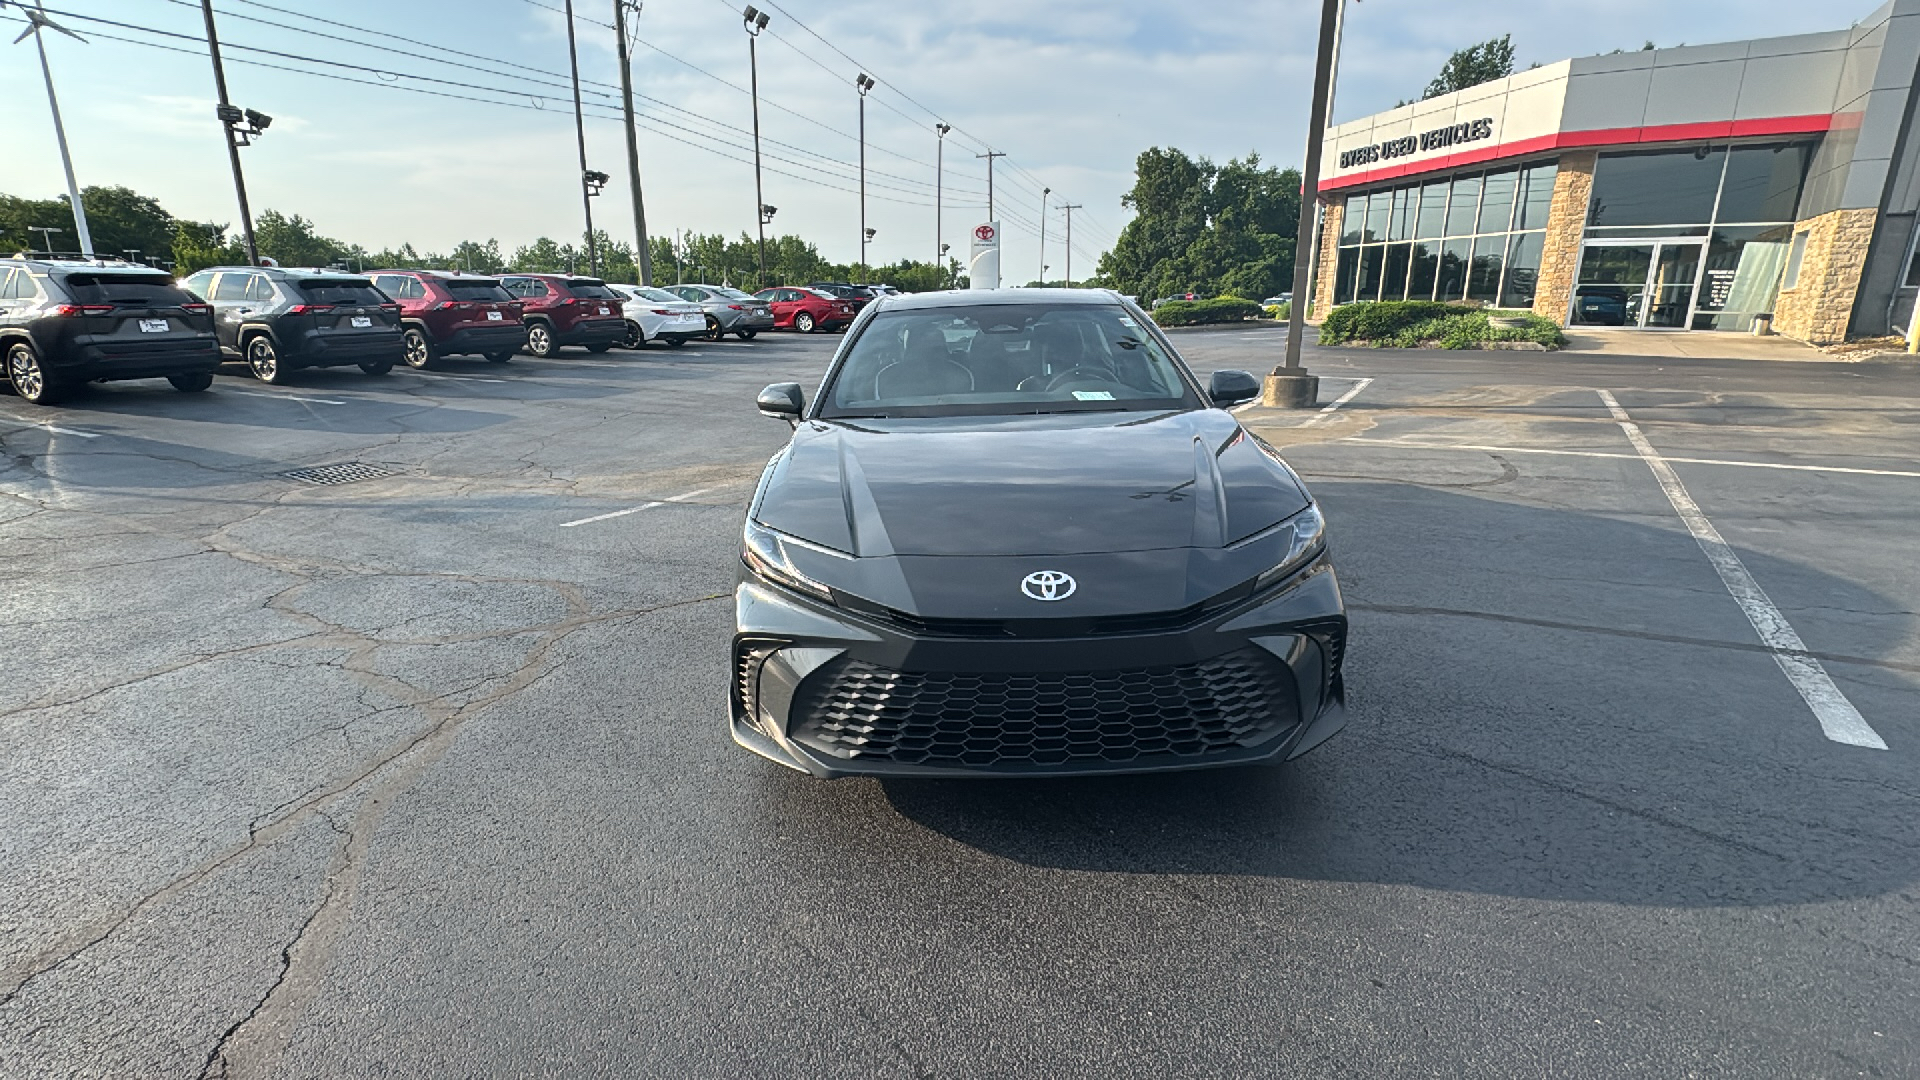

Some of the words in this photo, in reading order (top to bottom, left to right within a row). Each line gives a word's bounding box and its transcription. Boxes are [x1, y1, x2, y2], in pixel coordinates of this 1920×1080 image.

[1340, 144, 1380, 168] BYERS
[1380, 136, 1417, 160] USED
[1420, 118, 1492, 150] VEHICLES
